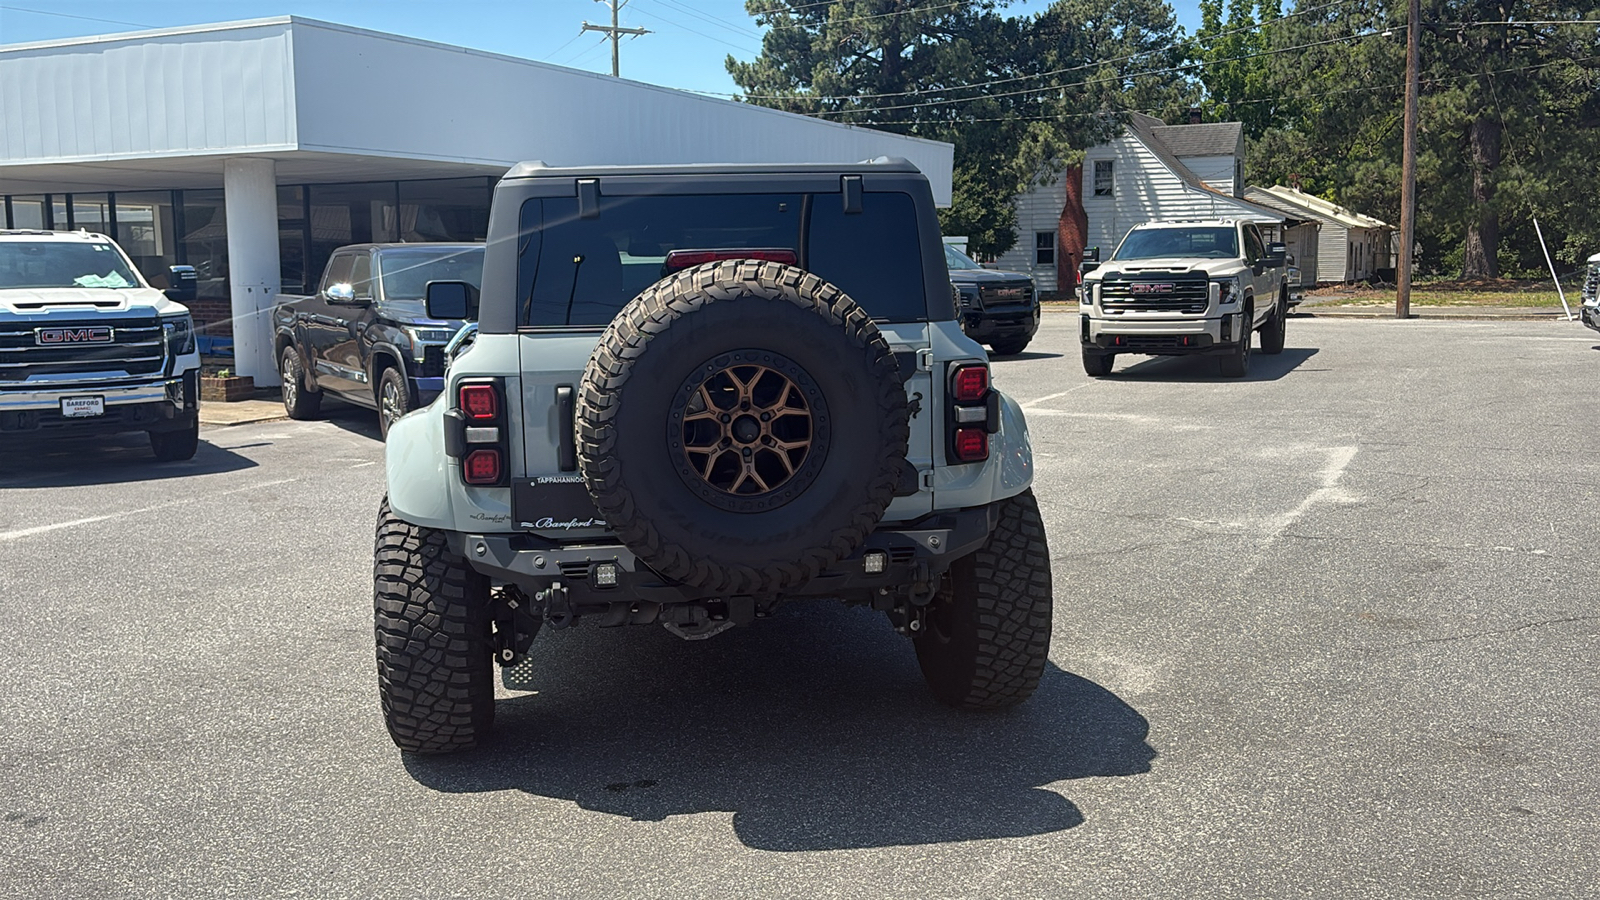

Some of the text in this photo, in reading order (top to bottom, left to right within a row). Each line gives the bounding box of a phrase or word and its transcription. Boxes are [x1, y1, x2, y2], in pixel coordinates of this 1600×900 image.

[1132, 284, 1172, 293] GMC
[42, 328, 109, 342] GMC
[535, 517, 594, 531] Bareford
